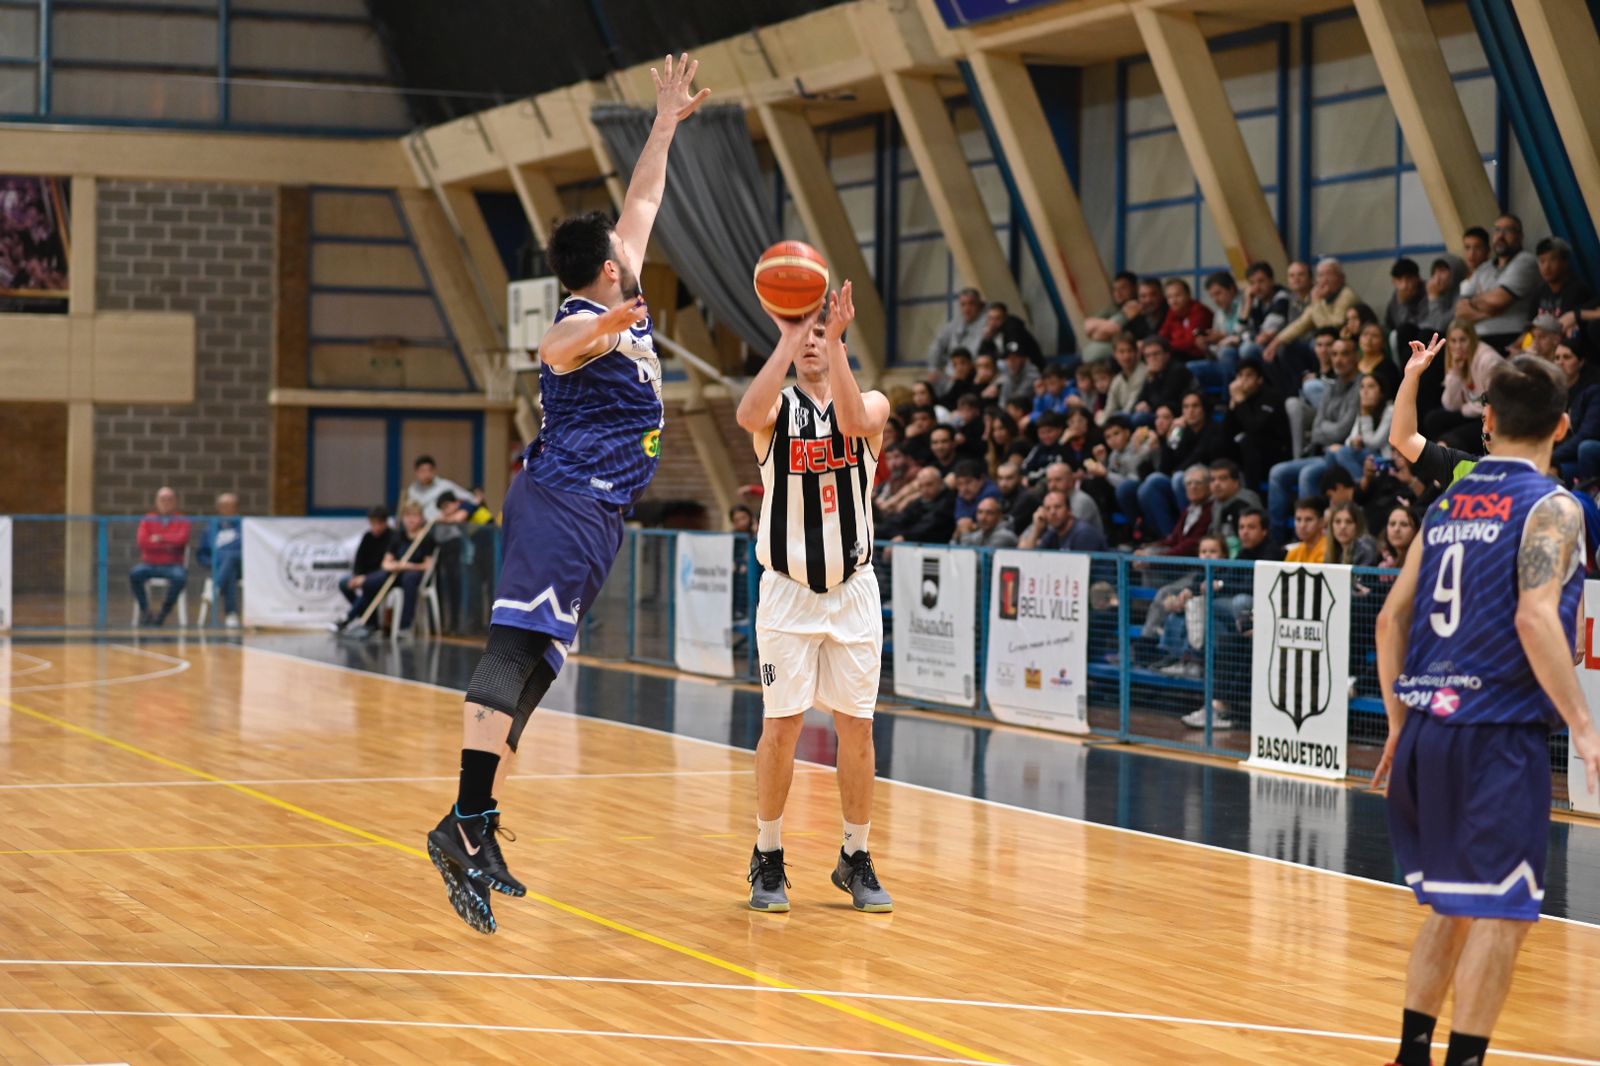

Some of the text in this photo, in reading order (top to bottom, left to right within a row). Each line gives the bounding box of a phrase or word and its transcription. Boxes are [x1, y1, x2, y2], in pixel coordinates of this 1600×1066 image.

[823, 485, 837, 513] 9
[1452, 493, 1513, 521] TICSA
[1430, 542, 1465, 637] 9
[1020, 596, 1079, 622] BELL VILLE
[1304, 626, 1321, 642] BELL
[1257, 736, 1340, 770] BASQUETBOL
